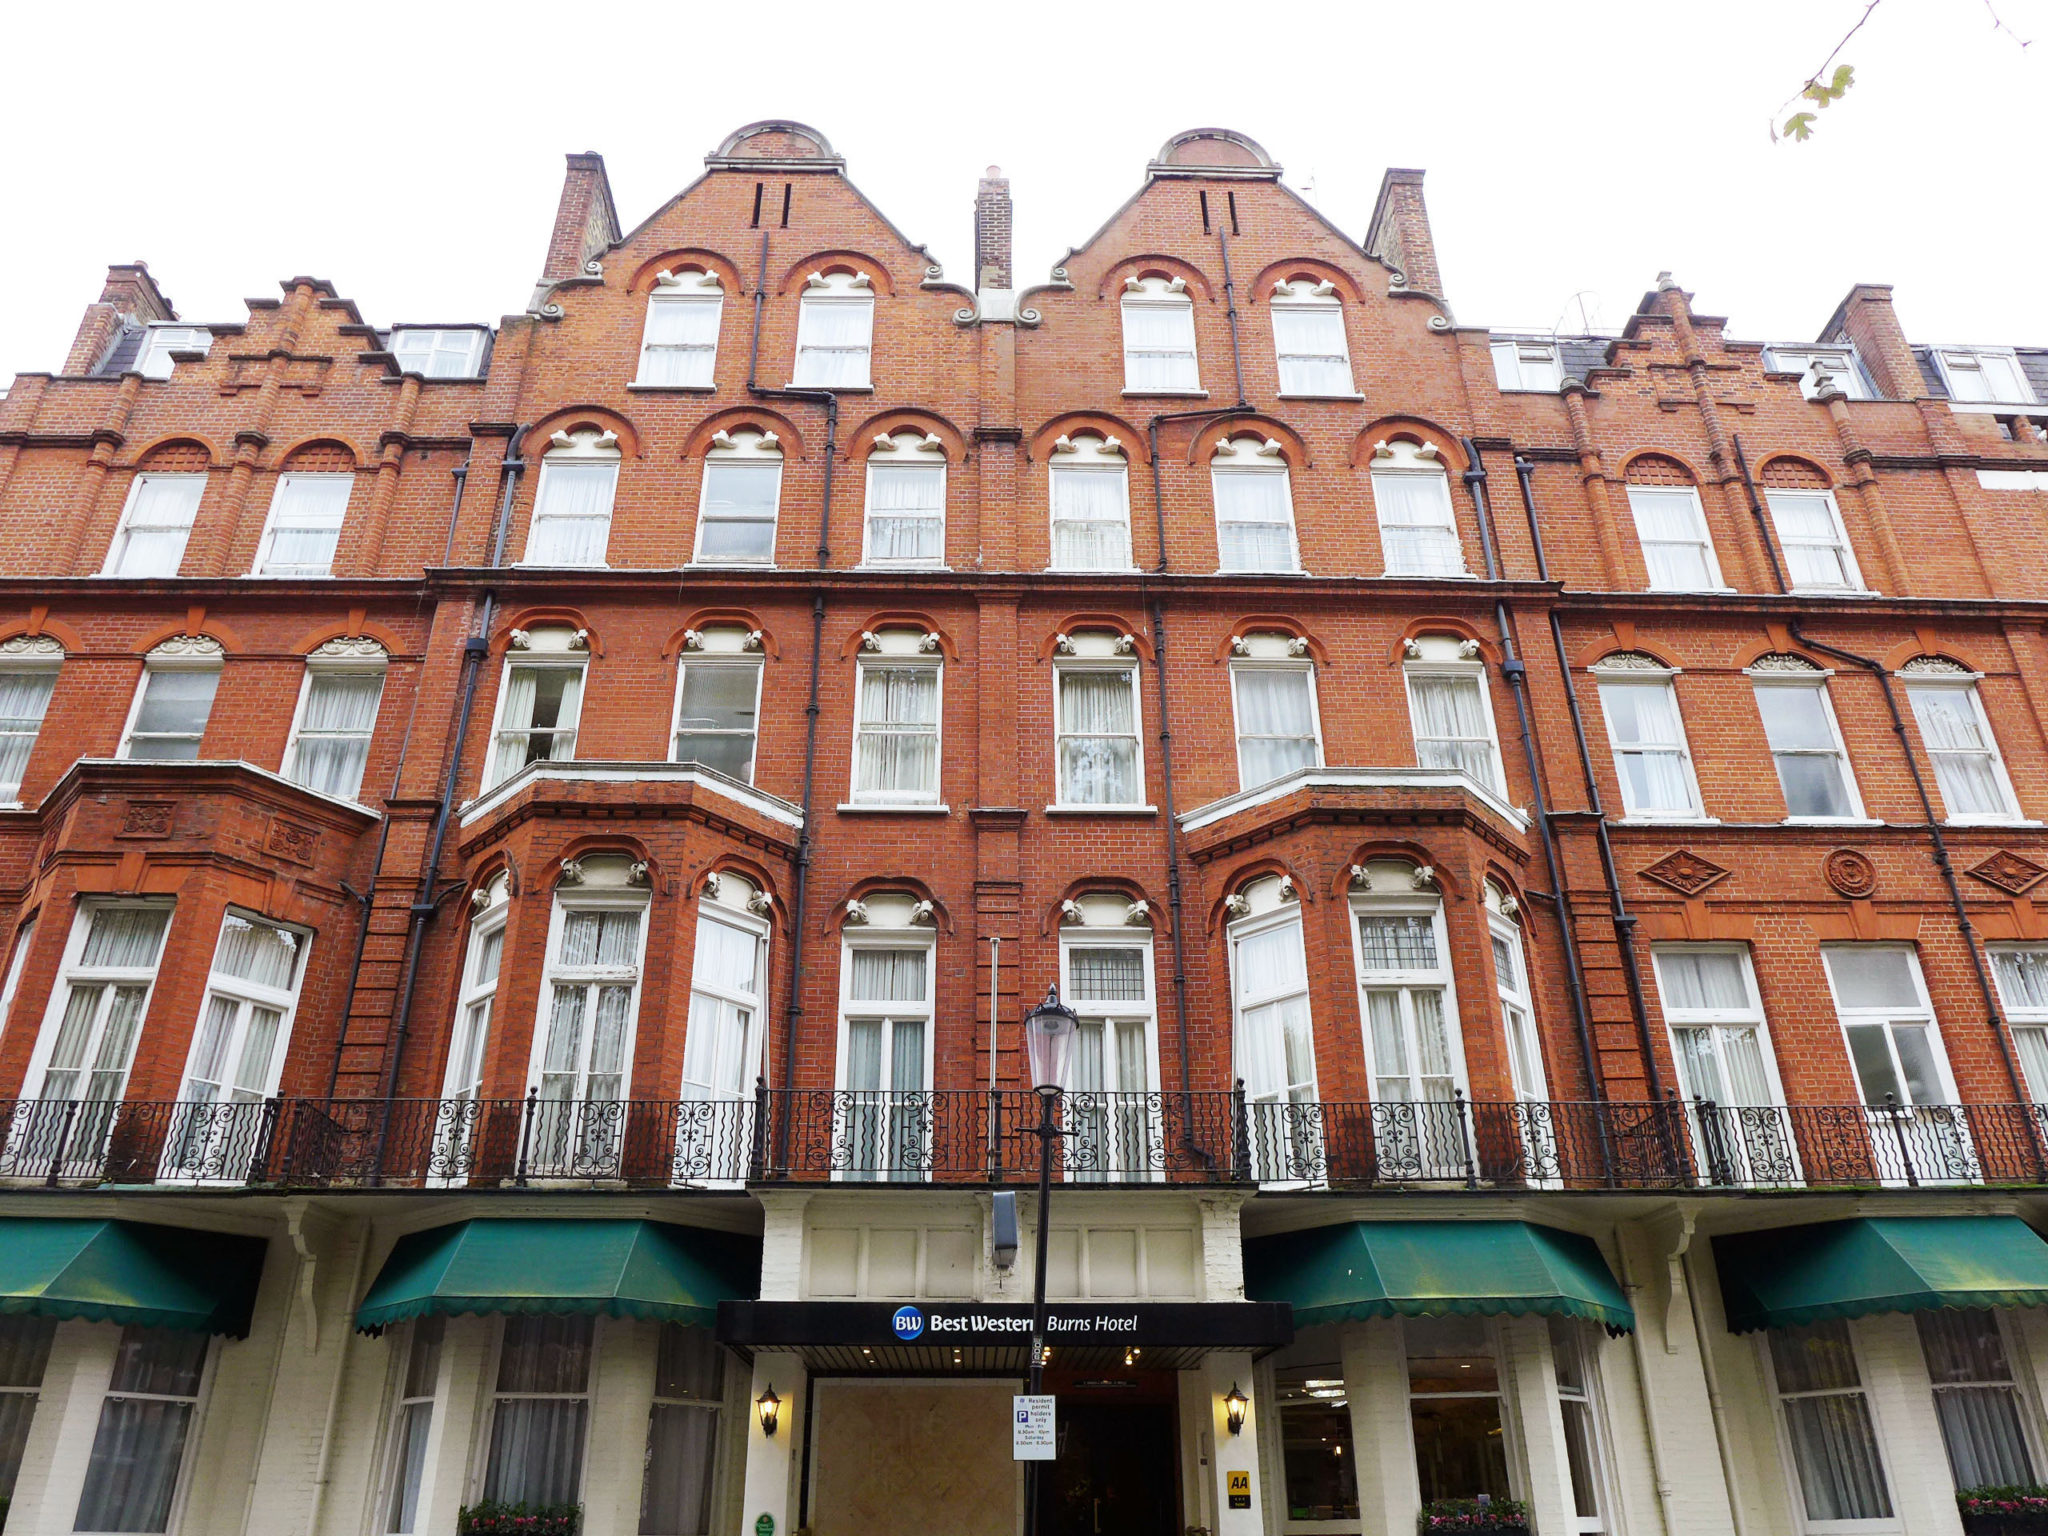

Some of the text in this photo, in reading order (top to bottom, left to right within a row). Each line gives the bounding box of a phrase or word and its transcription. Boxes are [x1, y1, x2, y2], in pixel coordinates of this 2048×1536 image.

[895, 1315, 922, 1331] BW
[930, 1315, 968, 1332] Best
[1046, 1315, 1091, 1332] Burns
[1095, 1315, 1138, 1332] Hotel
[1231, 1476, 1248, 1489] AA
